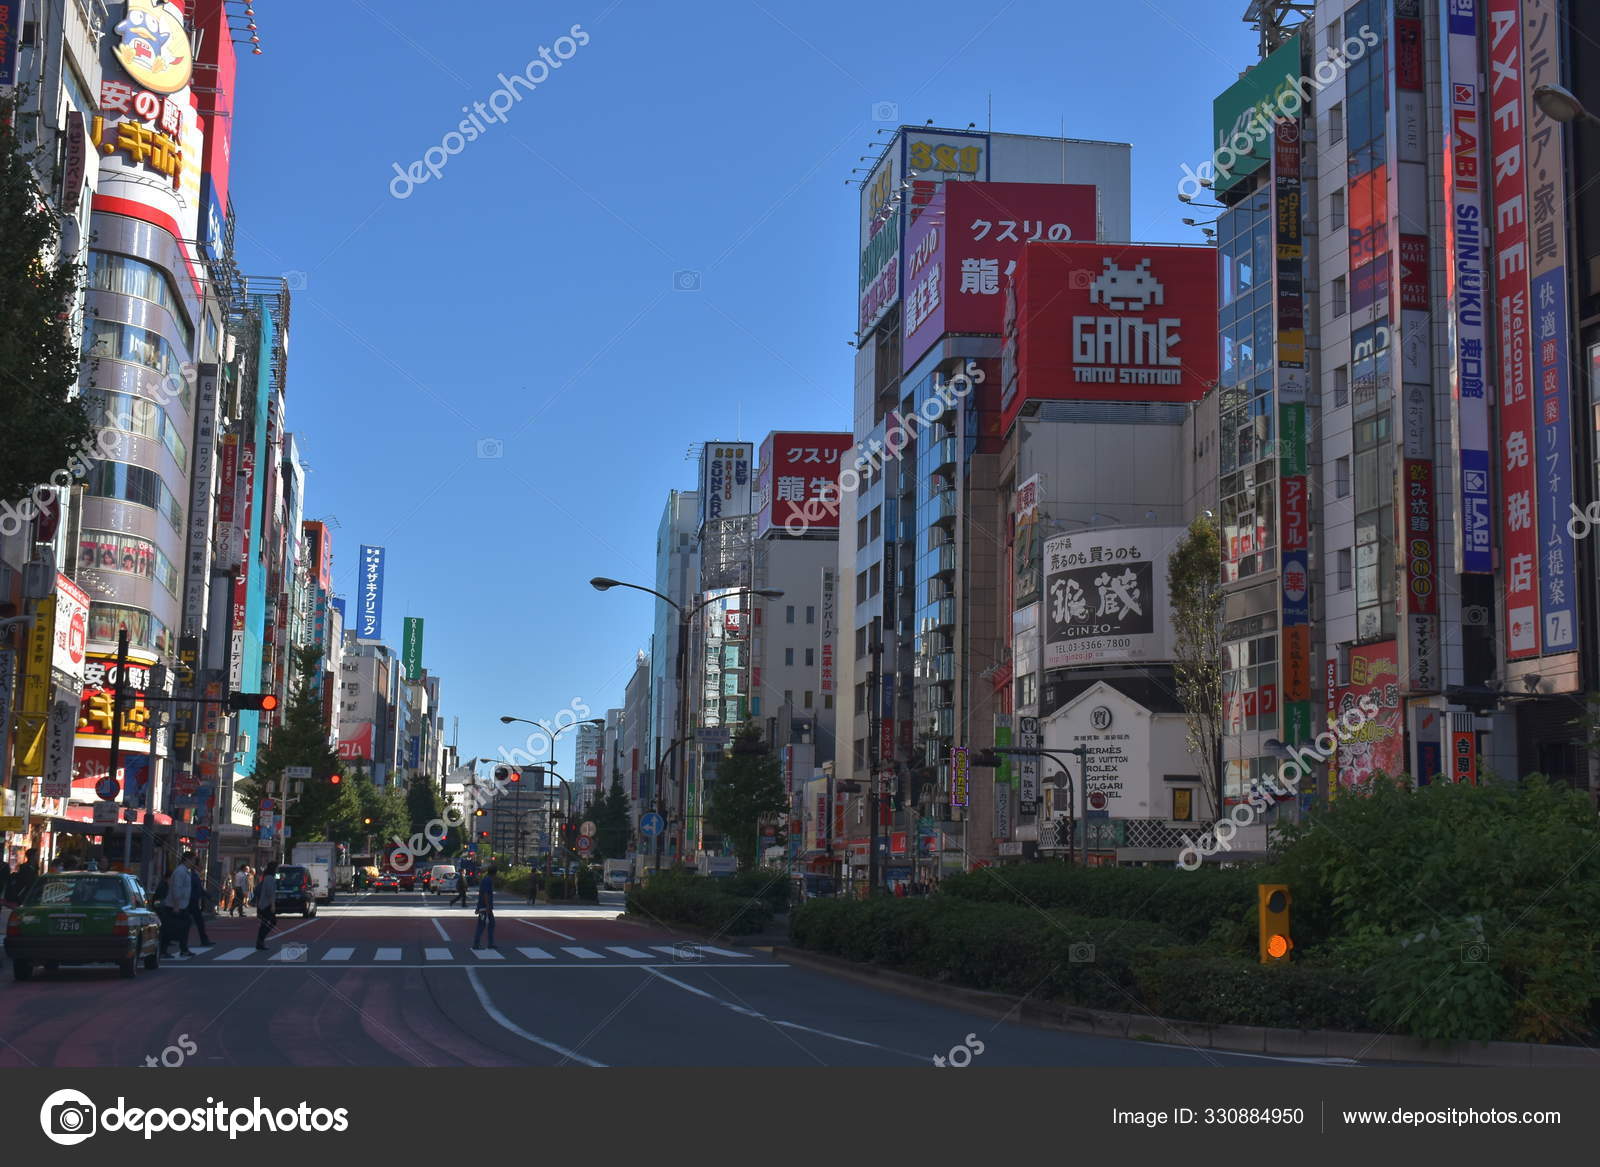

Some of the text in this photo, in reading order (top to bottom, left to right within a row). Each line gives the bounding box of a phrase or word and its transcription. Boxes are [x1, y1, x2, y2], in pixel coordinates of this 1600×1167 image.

[1453, 109, 1478, 193] LABI
[971, 218, 1072, 242] クスリの
[1456, 203, 1483, 399] SHINJUKU 東口館
[1072, 316, 1181, 366] GAME
[1512, 290, 1526, 402] Welcome!
[1073, 366, 1181, 384] TAITO STATION
[787, 448, 838, 464] クスリ
[710, 460, 723, 519] SUNPARK
[1286, 481, 1303, 545] アイフル
[1506, 431, 1532, 593] 免税店
[1471, 499, 1489, 552] LABI
[364, 564, 378, 636] オザキクリニック
[1284, 572, 1304, 592] 薬
